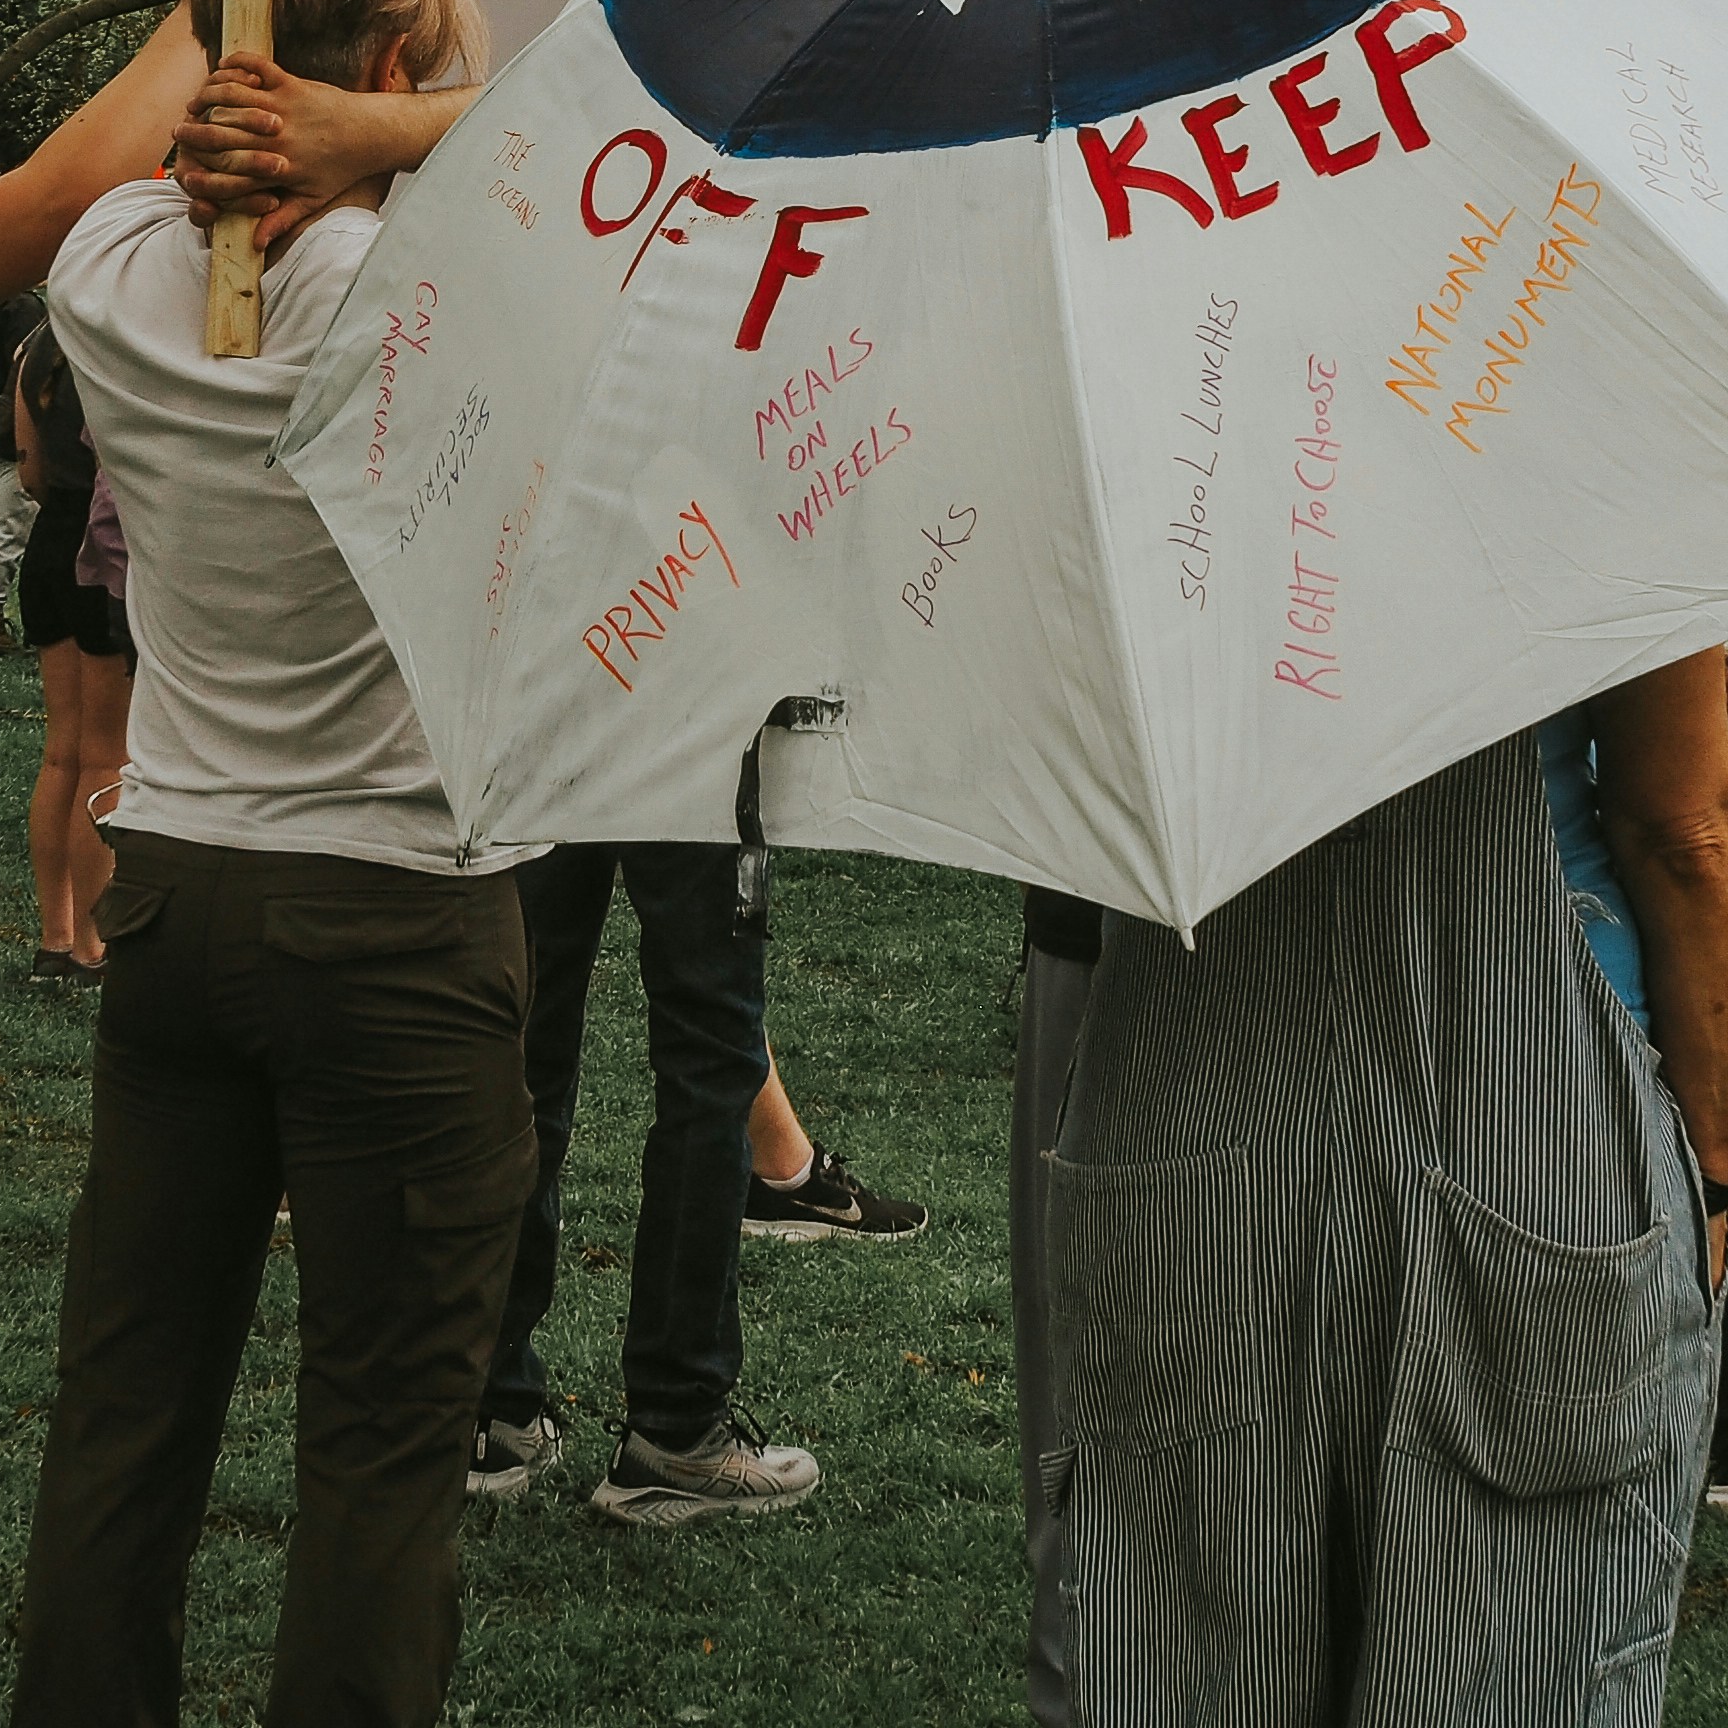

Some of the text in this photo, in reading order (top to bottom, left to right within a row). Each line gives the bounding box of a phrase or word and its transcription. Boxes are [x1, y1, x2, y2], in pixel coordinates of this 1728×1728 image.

[493, 130, 536, 173] THE
[1605, 41, 1684, 204] MEDICAL
[1658, 58, 1727, 214] RESEARCH
[487, 180, 542, 230] OCEANS
[580, 128, 870, 352] OFF
[399, 281, 439, 354] GAY
[1181, 292, 1239, 437] LUNCHES
[1385, 202, 1518, 416] NATIONAL
[1445, 163, 1602, 454] MONUMENTS
[364, 311, 404, 487] MARRIAGE
[756, 327, 872, 460] MEALS
[788, 421, 828, 470] ON
[778, 407, 914, 540] WHEELS
[582, 500, 739, 692] PRIVACY
[1275, 550, 1342, 701] RIGHT
